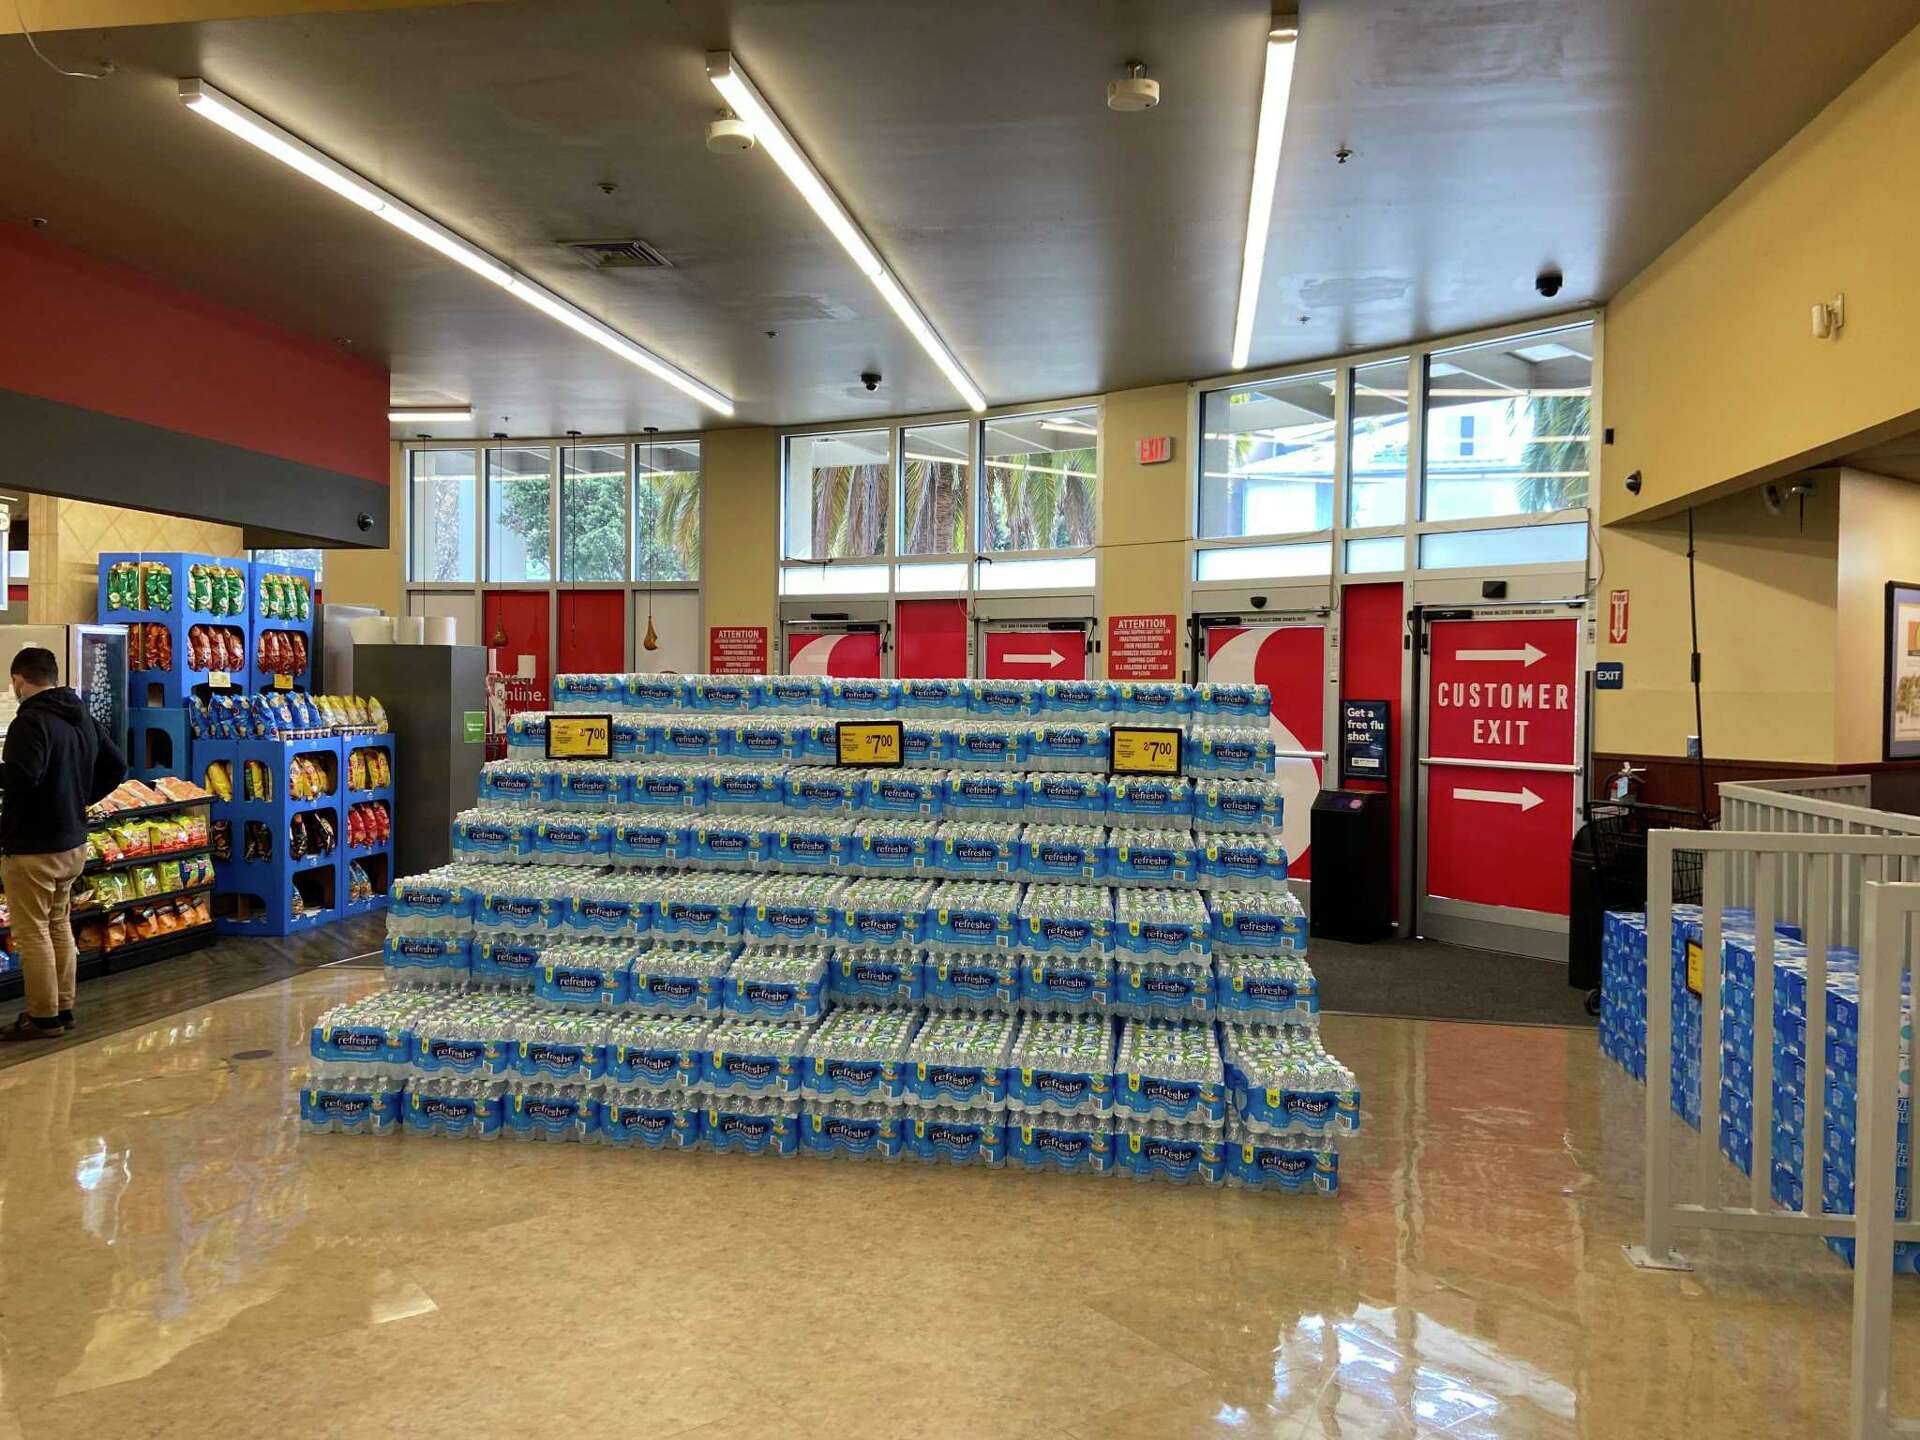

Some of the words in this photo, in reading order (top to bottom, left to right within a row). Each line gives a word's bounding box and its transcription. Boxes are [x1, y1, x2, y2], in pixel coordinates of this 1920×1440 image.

[1141, 440, 1167, 460] EXIT
[1118, 619, 1166, 628] ATTENTION
[719, 630, 759, 638] ATTENTION
[1597, 671, 1621, 680] EXIT
[504, 687, 546, 702] nline.
[1438, 682, 1569, 710] CUSTOMER
[1347, 707, 1365, 717] Get
[1347, 720, 1367, 729] free
[1370, 721, 1384, 730] flu
[1347, 731, 1373, 741] shot.
[1473, 719, 1529, 746] EXIT
[971, 740, 1001, 749] refreshe
[1049, 735, 1081, 744] refreshe
[1216, 749, 1248, 759] refreshe
[497, 781, 526, 789] refreshe
[574, 781, 604, 790] refreshe
[649, 784, 679, 793] refreshe
[726, 781, 757, 790] refreshe
[966, 785, 998, 795] refreshe
[1047, 786, 1080, 795] refreshe
[806, 788, 837, 798] refreshe
[885, 790, 915, 799] refreshe
[1132, 791, 1164, 801] refreshe
[1223, 801, 1257, 811] refreshe
[472, 832, 505, 840] refreshe
[550, 832, 581, 841] refreshe
[630, 835, 661, 844] refreshe
[711, 838, 743, 847] refreshe
[793, 841, 825, 851] refreshe
[877, 844, 909, 853] refreshe
[959, 848, 992, 858] refreshe
[1044, 853, 1078, 862] refreshe
[1133, 855, 1169, 866] refreshe
[1224, 853, 1258, 864] refreshe
[408, 895, 442, 904] refreshe
[498, 903, 534, 914] refreshe
[586, 907, 622, 917] refreshe
[675, 910, 712, 921] refreshe
[772, 914, 809, 924] refreshe
[861, 919, 897, 930] refreshe
[955, 918, 991, 929] refreshe
[1240, 922, 1276, 933] refreshe
[1048, 926, 1084, 938] refreshe
[1146, 930, 1184, 941] refreshe
[405, 944, 439, 954] refreshe
[497, 953, 530, 964] refreshe
[560, 976, 596, 987] refreshe
[857, 971, 893, 982] refreshe
[954, 975, 990, 985] refreshe
[1050, 977, 1086, 988] refreshe
[1148, 982, 1185, 993] refreshe
[654, 983, 691, 994] refreshe
[1251, 984, 1288, 996] refreshe
[751, 990, 789, 1002] refreshe
[337, 1035, 378, 1045] refreshe
[436, 1047, 475, 1059] refreshe
[534, 1051, 575, 1063] refreshe
[632, 1056, 672, 1069] refreshe
[729, 1062, 770, 1074] refreshe
[832, 1067, 873, 1080] refreshe
[934, 1073, 975, 1086] refreshe
[1040, 1079, 1082, 1093] refreshe
[1147, 1086, 1190, 1100] refreshe
[324, 1099, 364, 1111] refreshe
[427, 1104, 467, 1116] refreshe
[1287, 1098, 1329, 1112] refreshe
[529, 1105, 569, 1117] refreshe
[625, 1115, 666, 1128] refreshe
[724, 1121, 764, 1135] refreshe
[829, 1125, 871, 1138] refreshe
[931, 1131, 973, 1143] refreshe
[1040, 1137, 1082, 1152] refreshe
[1148, 1146, 1191, 1160] refreshe
[1262, 1156, 1306, 1170] refreshe
